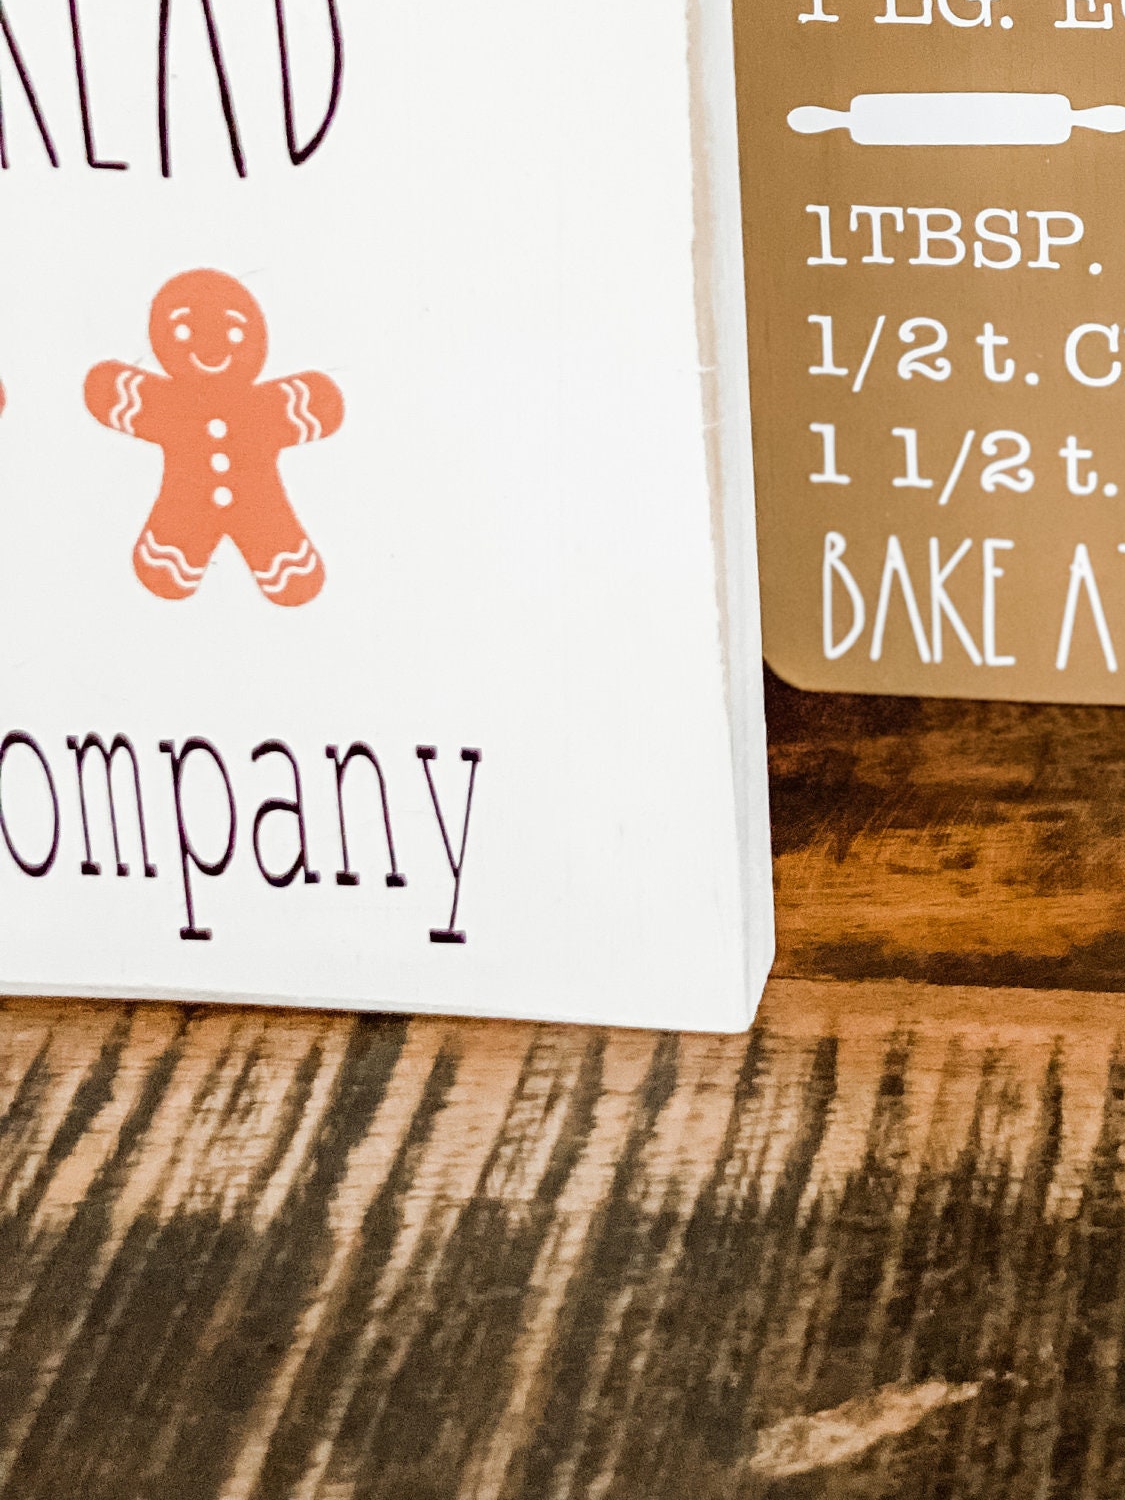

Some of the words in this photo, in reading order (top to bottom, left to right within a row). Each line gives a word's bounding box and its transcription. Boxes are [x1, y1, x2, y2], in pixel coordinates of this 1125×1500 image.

[809, 316, 952, 392] 1/2
[977, 324, 1040, 386] t.
[811, 425, 851, 484] 1
[893, 429, 1035, 505] 1/2
[1061, 437, 1118, 497] t.
[825, 533, 1016, 667] BAKE
[0, 734, 481, 944] ompany
